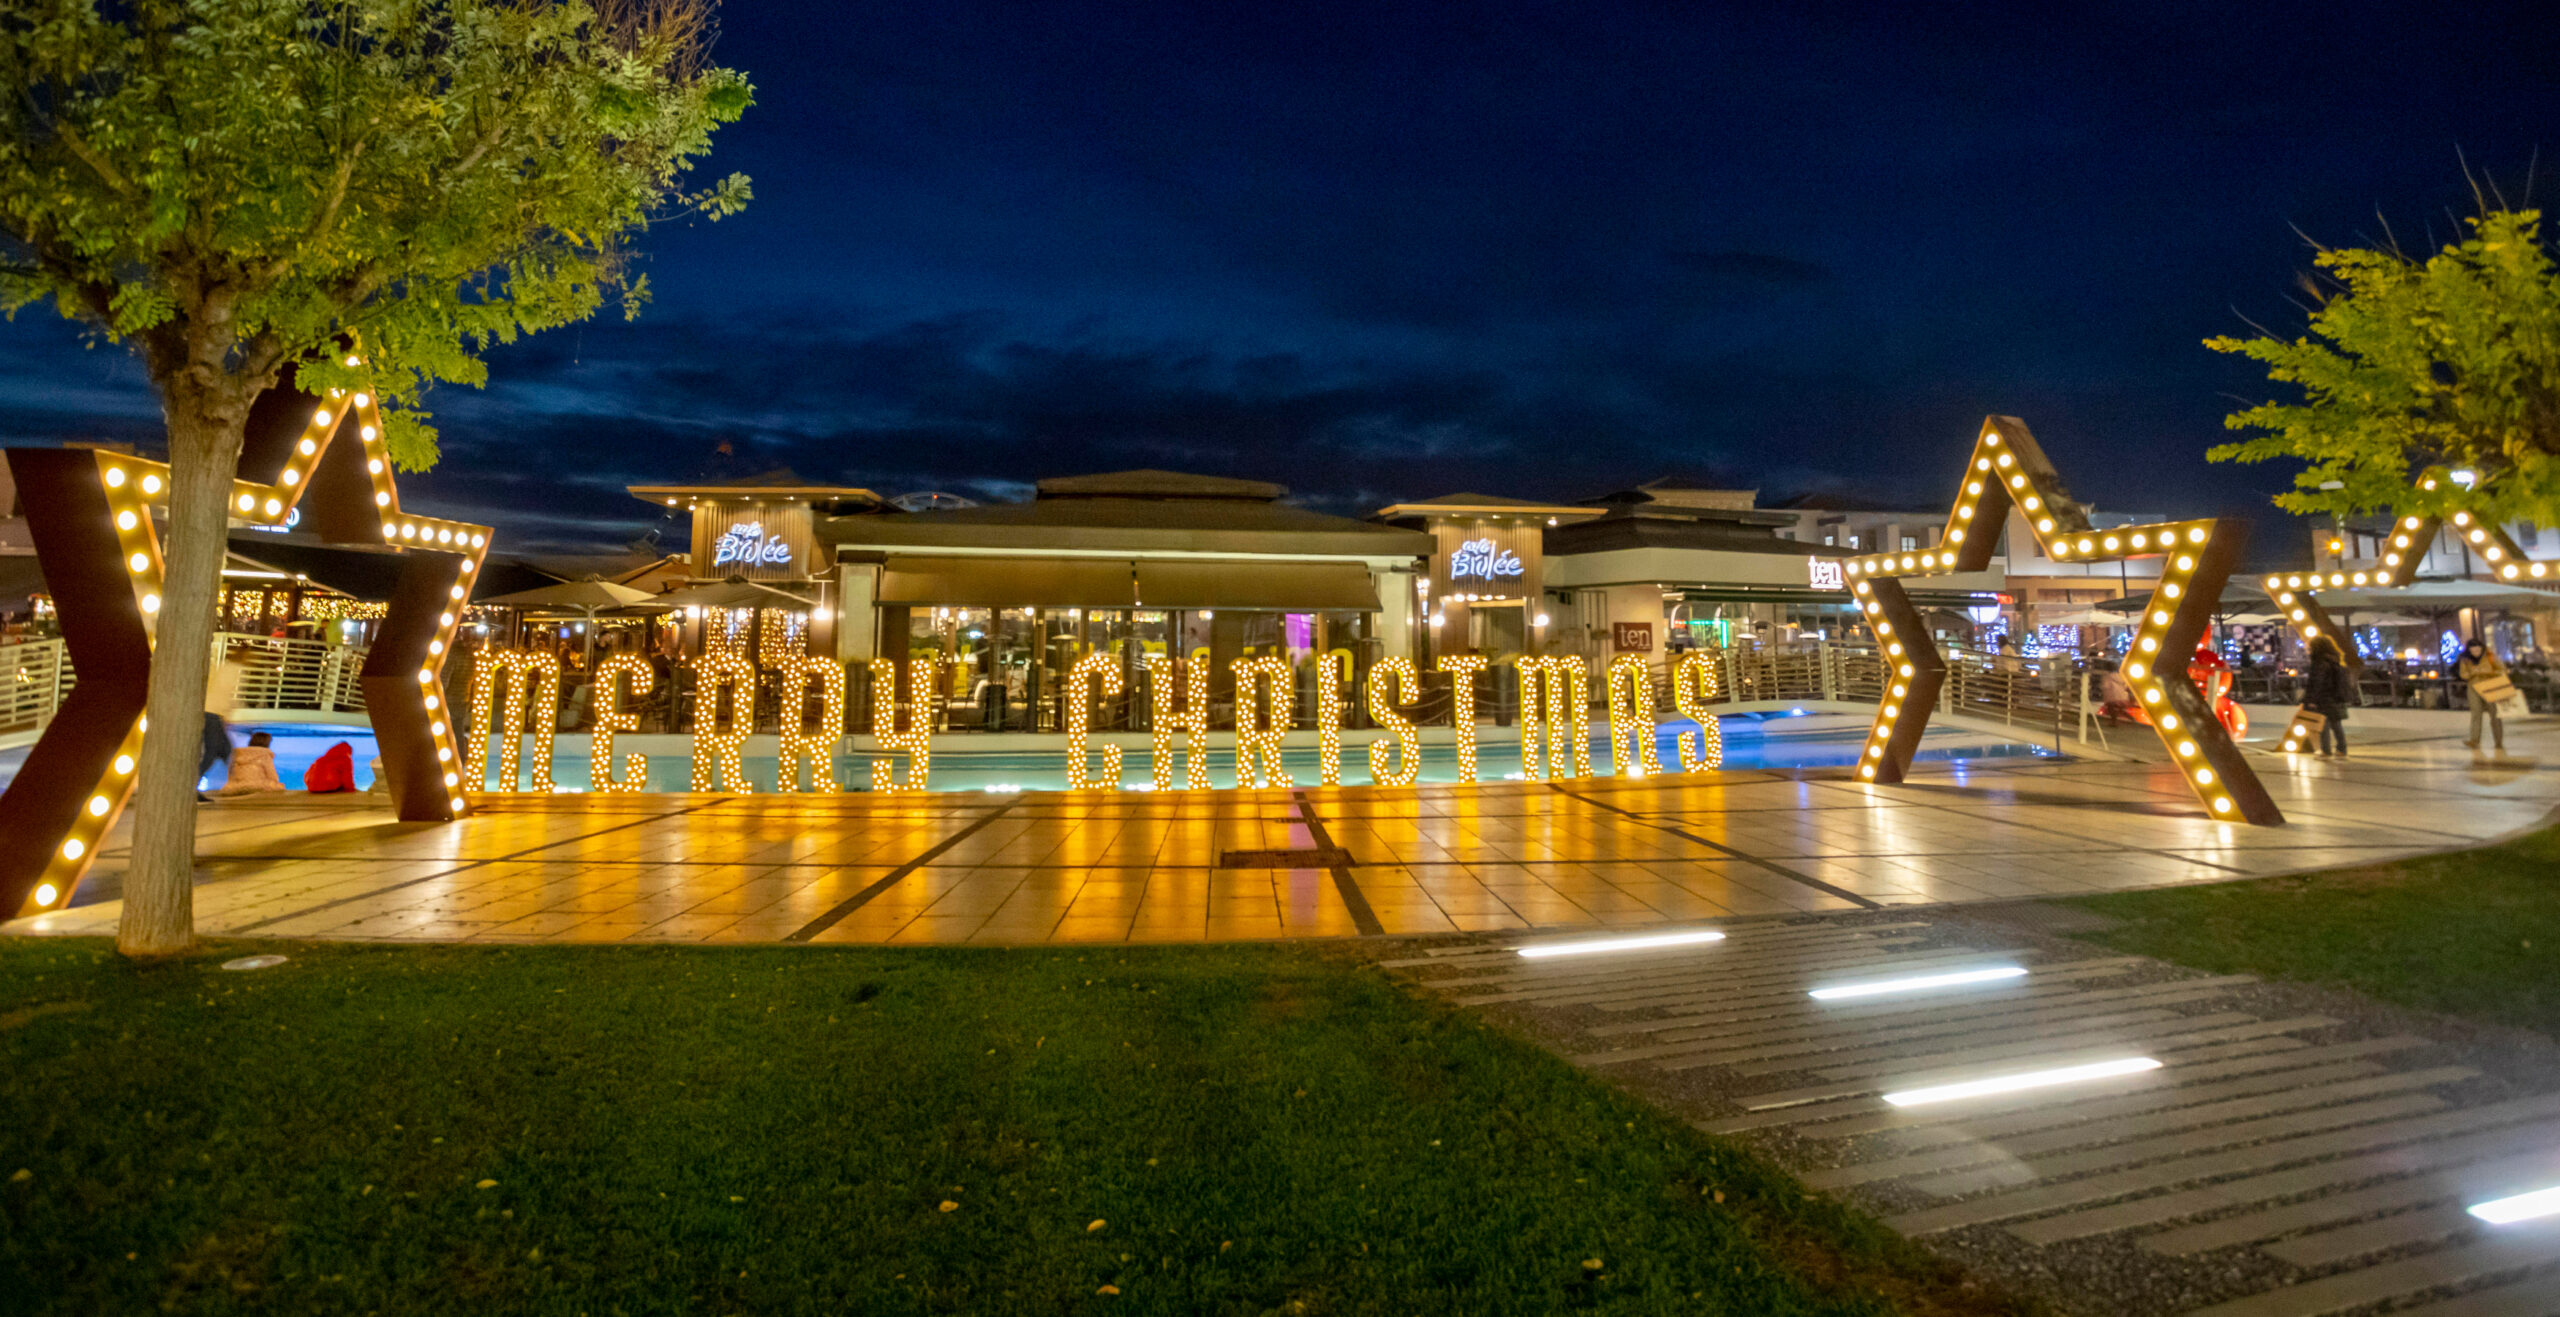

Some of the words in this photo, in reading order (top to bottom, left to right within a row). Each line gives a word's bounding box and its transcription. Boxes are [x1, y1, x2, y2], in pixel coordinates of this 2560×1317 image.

[1808, 555, 1843, 585] ten
[1618, 624, 1650, 647] ten
[465, 648, 931, 794] MERRY
[1067, 652, 1722, 792] CHRISTMAS
